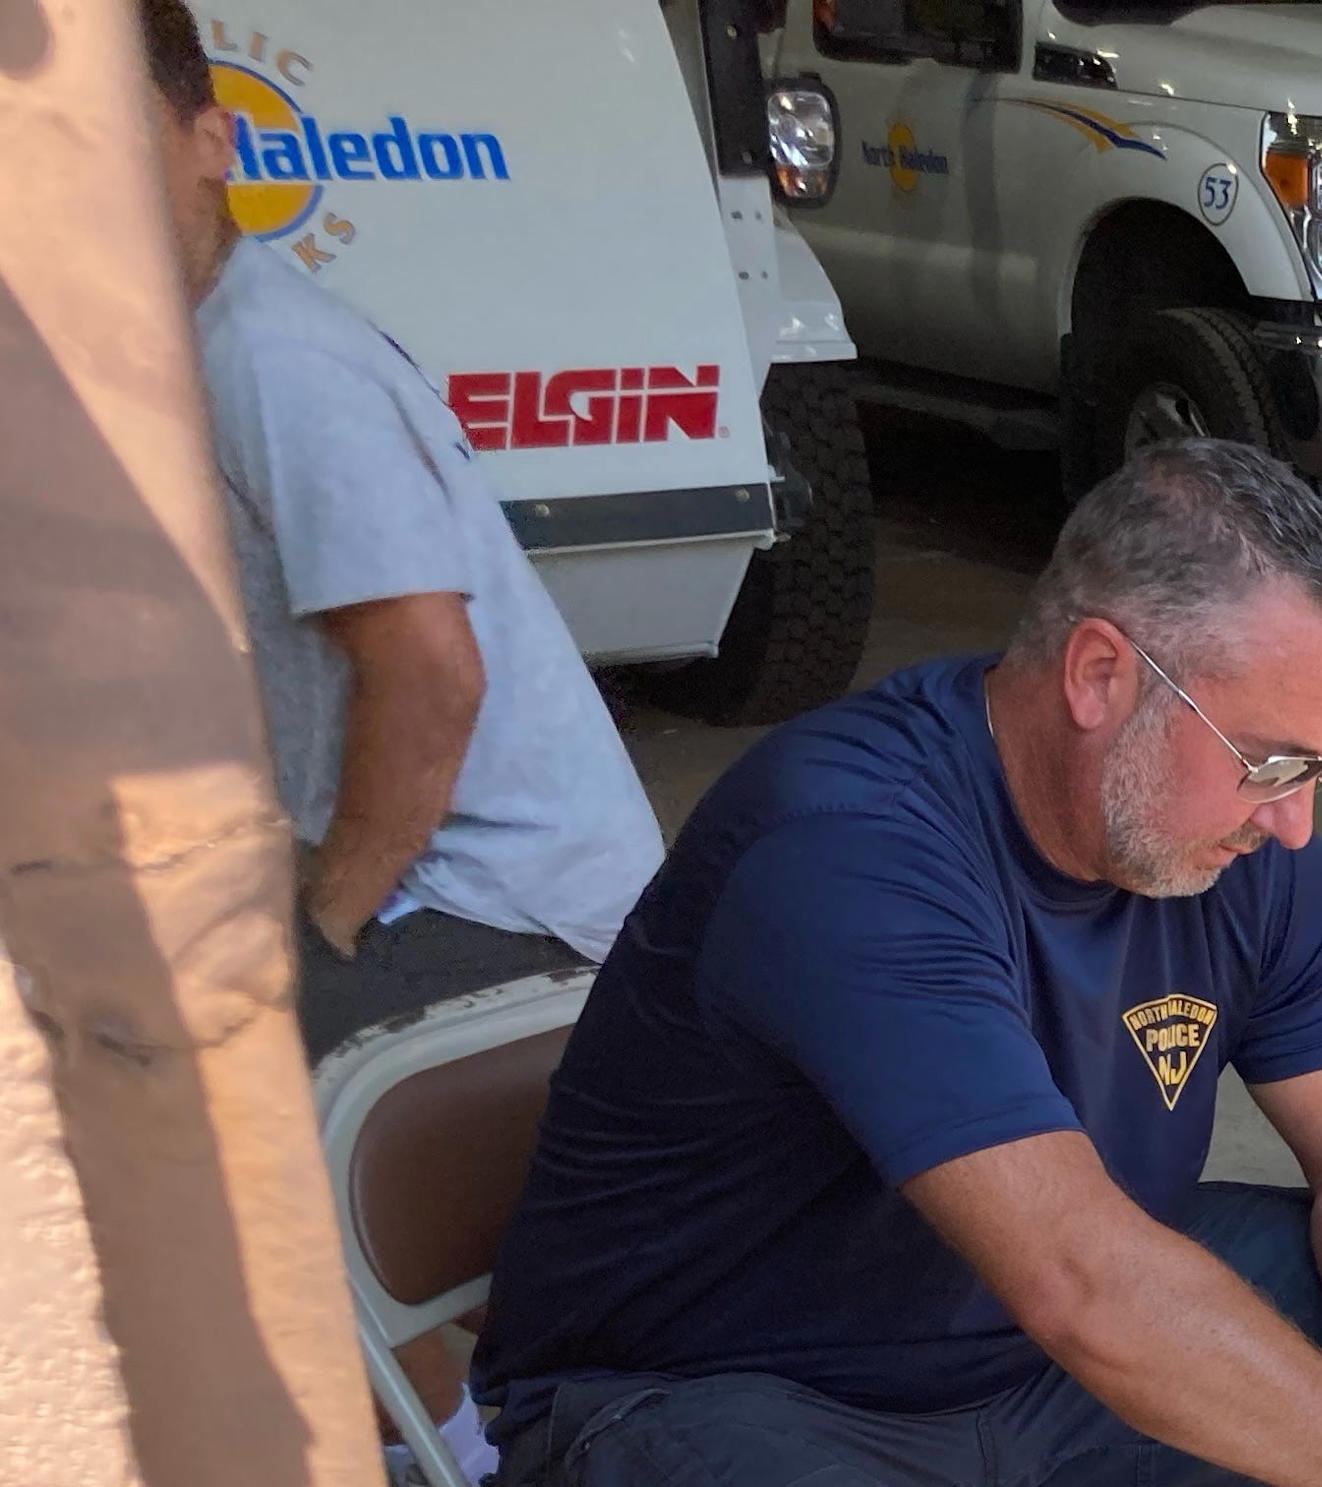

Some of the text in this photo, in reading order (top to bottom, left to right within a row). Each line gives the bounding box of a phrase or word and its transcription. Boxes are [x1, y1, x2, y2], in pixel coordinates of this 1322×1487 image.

[210, 18, 314, 88] LIC
[1203, 176, 1232, 209] 53
[447, 364, 720, 453] ELGIN
[1129, 1004, 1168, 1031] NORTH
[1146, 1023, 1200, 1052] POLICE
[1158, 1051, 1187, 1086] NJ
